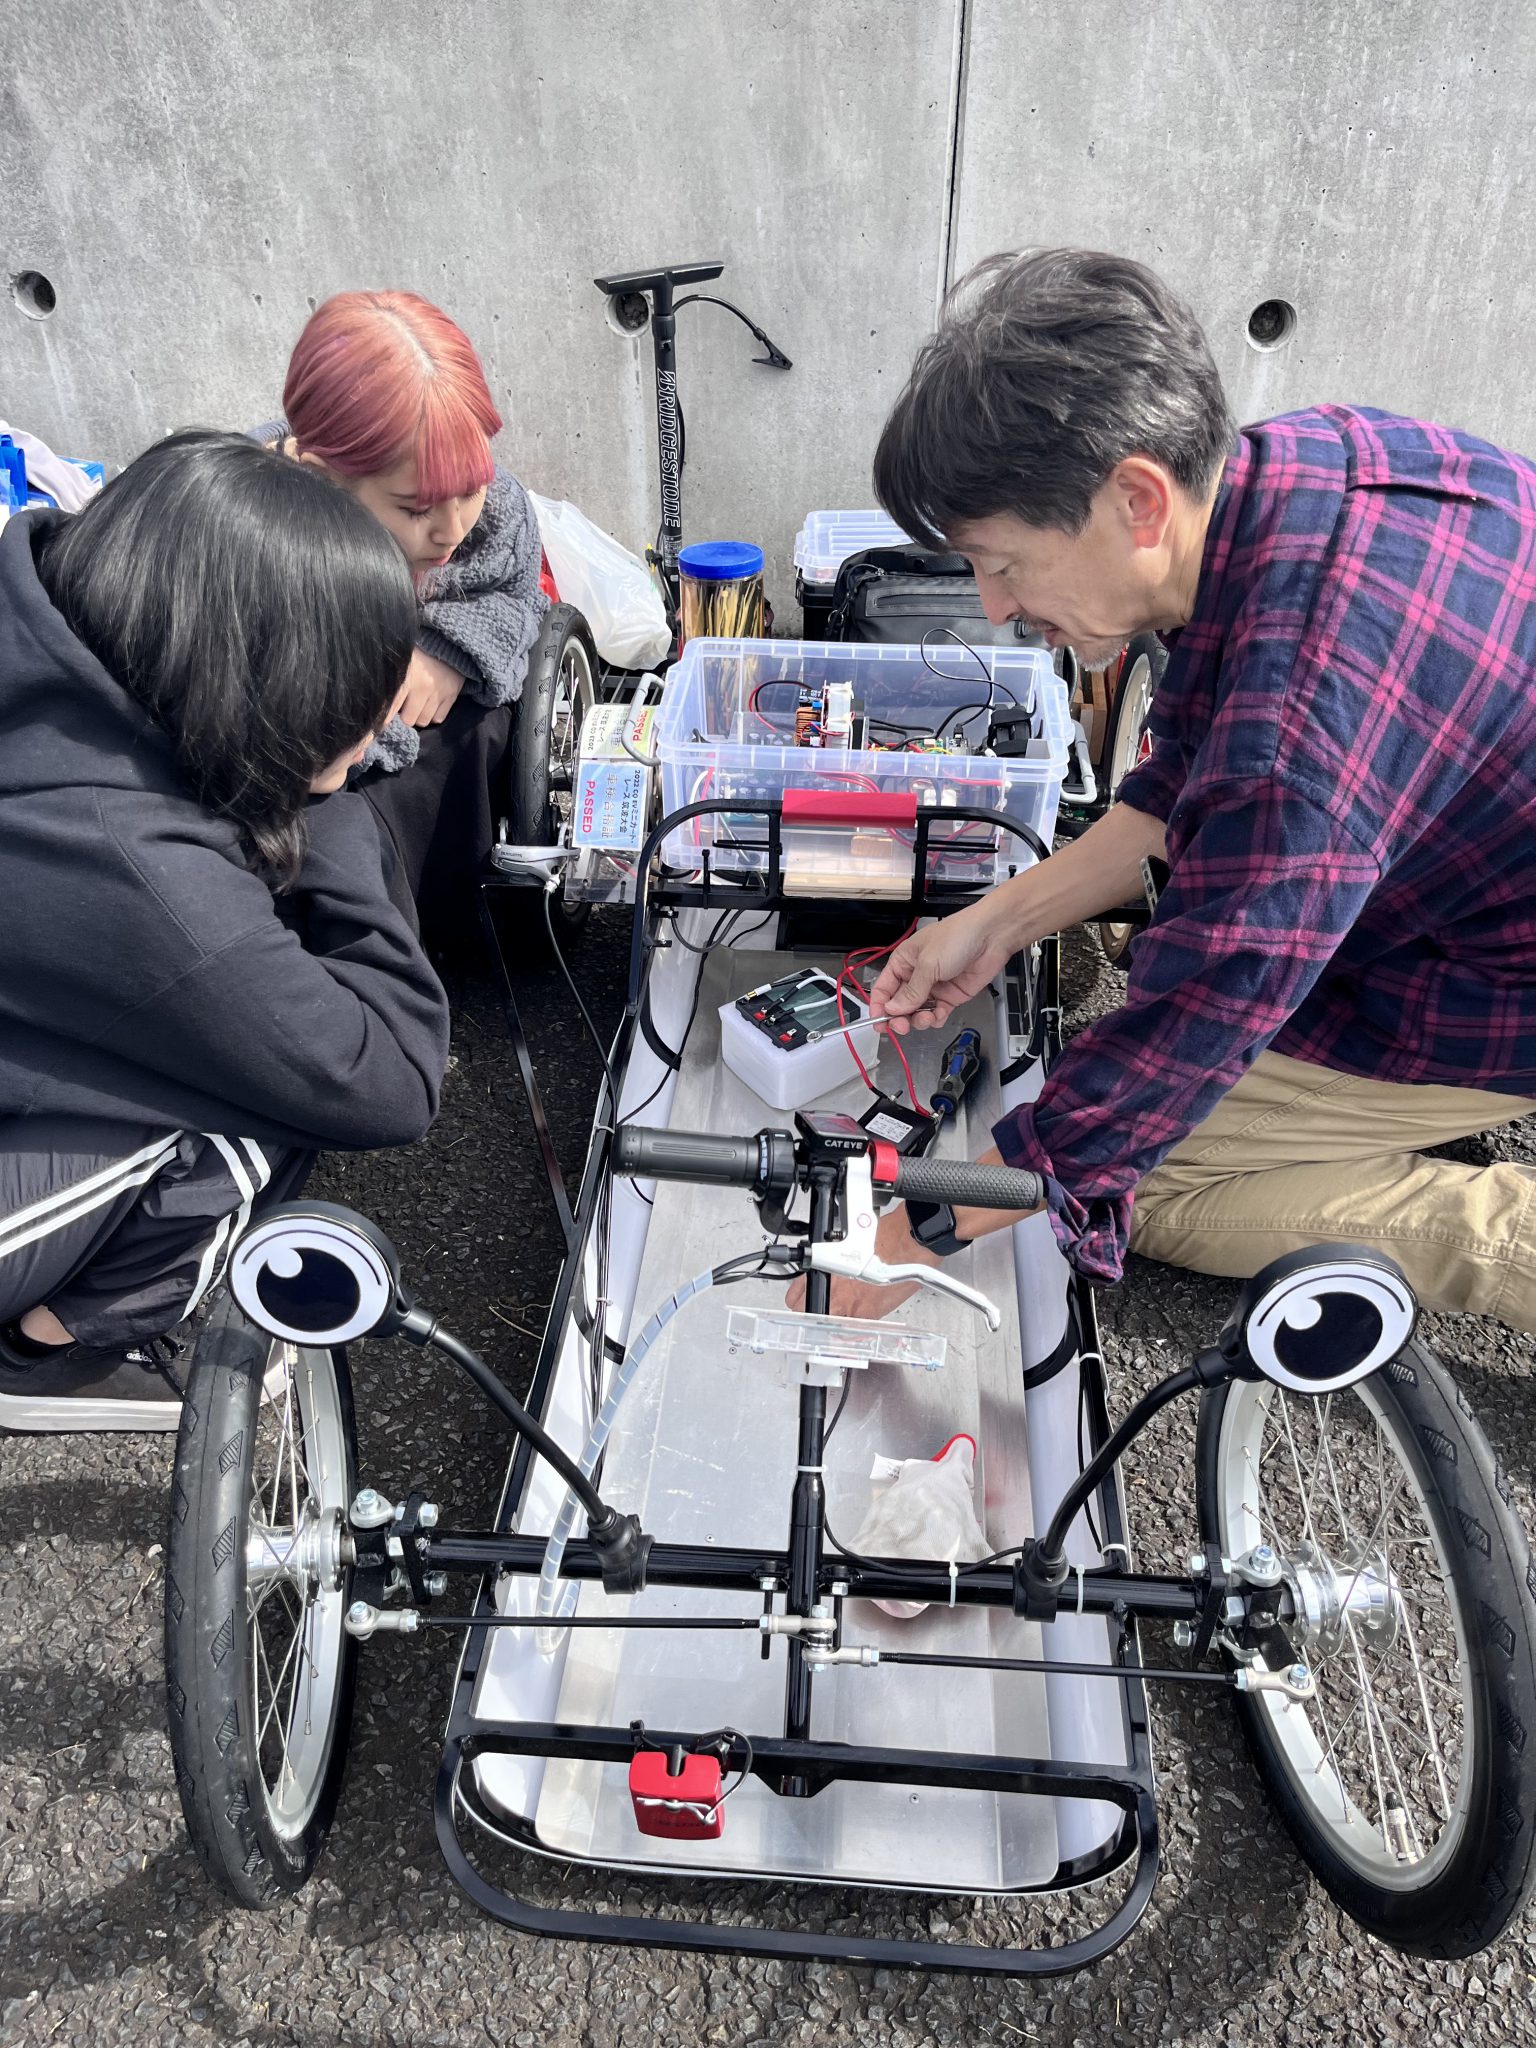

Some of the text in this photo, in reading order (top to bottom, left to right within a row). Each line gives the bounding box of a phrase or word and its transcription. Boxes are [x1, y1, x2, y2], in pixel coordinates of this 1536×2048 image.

[657, 368, 681, 528] BRIDGESTONE
[633, 769, 641, 787] 2022
[582, 780, 596, 833] PASSED
[824, 1139, 863, 1150] CATEYE
